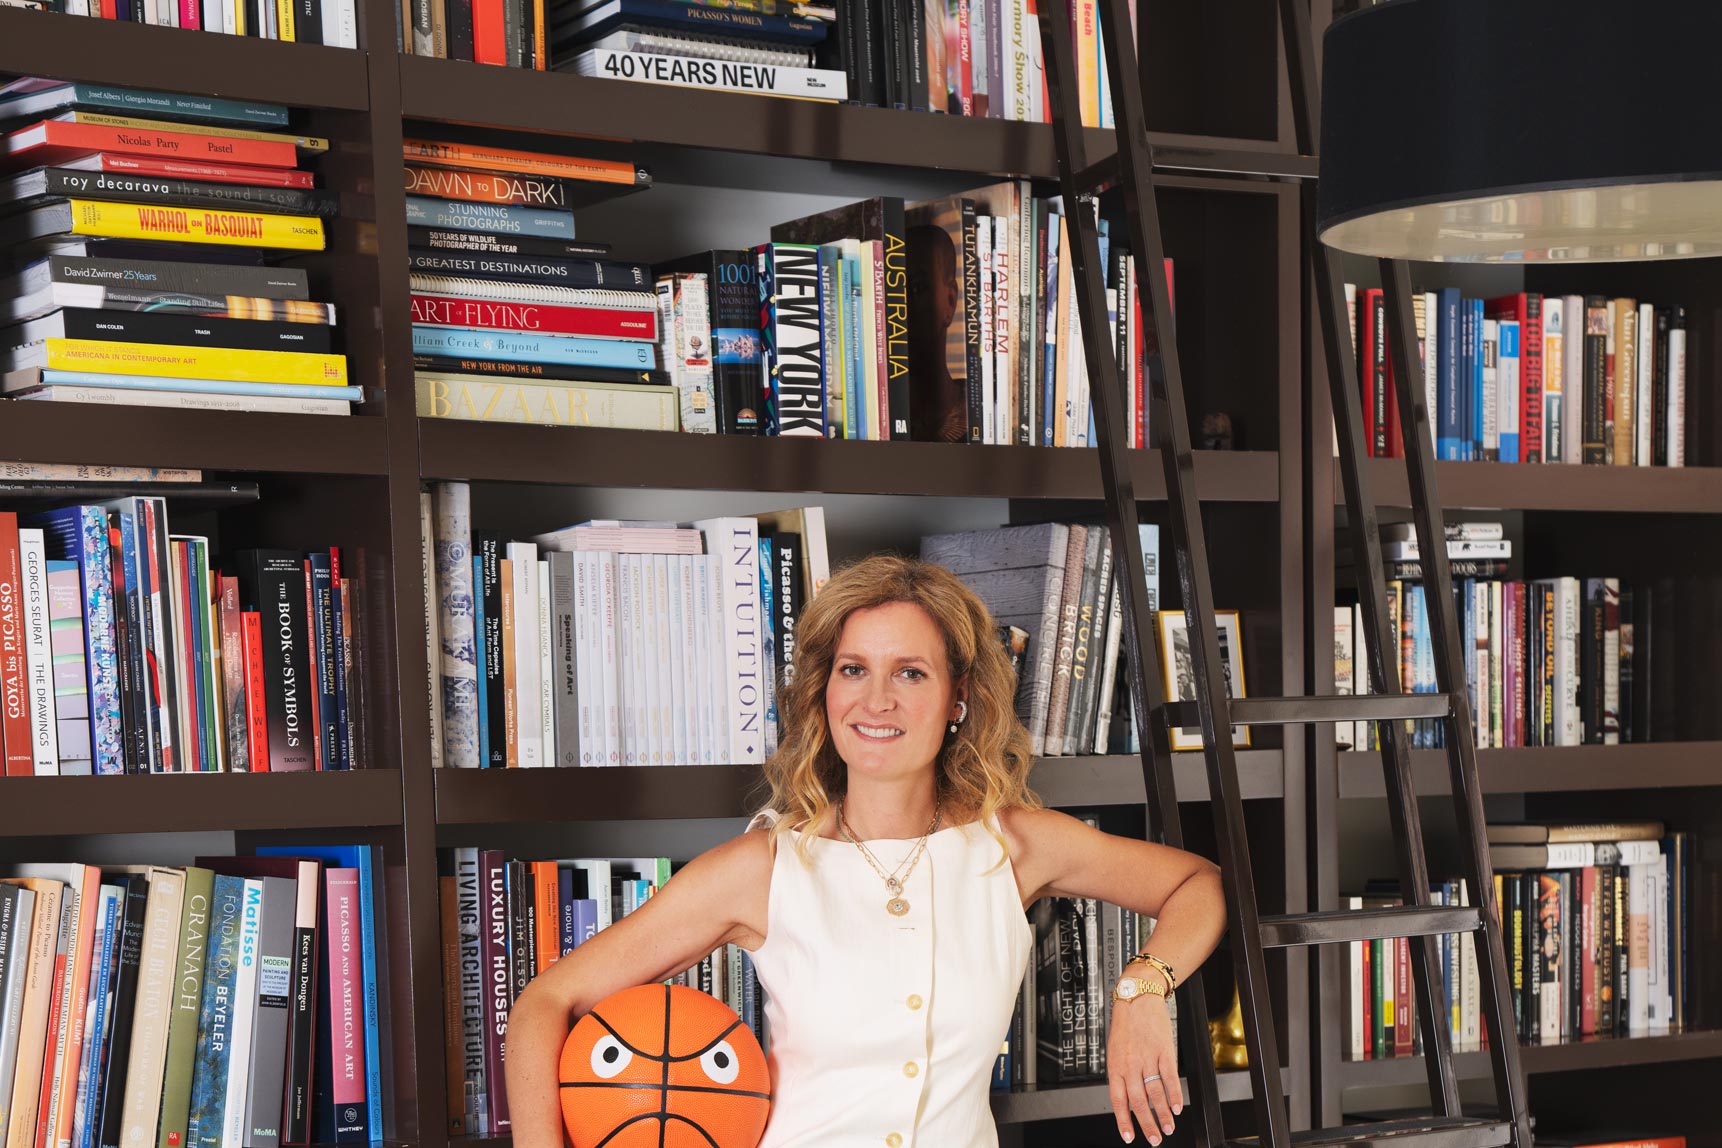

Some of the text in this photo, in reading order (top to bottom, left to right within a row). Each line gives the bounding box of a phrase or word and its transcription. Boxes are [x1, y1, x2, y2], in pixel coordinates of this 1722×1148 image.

[731, 14, 762, 26] WOMEN
[605, 54, 776, 89] 40 YEARS NEW
[118, 135, 233, 153] Nicolas Party Pastel
[63, 175, 169, 193] roy decarava
[404, 168, 472, 195] DAWN
[494, 178, 558, 205] DARK
[138, 208, 190, 234] WARHOL
[205, 216, 263, 239] BASQUIAT
[292, 227, 317, 235] TASCHEN
[438, 214, 520, 232] PHOTOGRAPHS
[449, 204, 508, 218] STUNNING
[535, 219, 565, 228] GRIFFITHS
[64, 267, 89, 277] David
[91, 268, 122, 279] Zwirner
[417, 257, 567, 276] GREATEST DESTINATIONS
[964, 225, 978, 345] TUTANKHAMUN
[411, 300, 455, 322] ART
[466, 304, 539, 329] FLYING
[885, 233, 909, 379] AUSTRALIA
[997, 253, 1009, 354] HARLEM
[66, 351, 110, 359] AMERICANA
[122, 355, 181, 364] CONTEMPORARY
[774, 247, 825, 437] NEW YORK
[462, 361, 542, 374] NEW YORK FROM THE AIR
[426, 380, 590, 425] BAZAAR
[28, 552, 49, 746] GEORGES SEURAT THE DRAWINGS
[279, 602, 293, 651] BOOK
[325, 608, 333, 654] ULTIMATE
[564, 615, 572, 662] Speaking
[733, 528, 758, 733] INTUITION
[1058, 605, 1077, 676] BRICK
[1074, 605, 1092, 680] WOOD
[1, 582, 20, 718] GOYA bis PICASSO
[566, 664, 572, 674] of
[327, 658, 335, 696] TROPHY
[283, 667, 300, 747] SYMBOLS
[242, 887, 261, 967] Matisse
[303, 935, 311, 957] Kees
[340, 897, 349, 952] PICASSO
[181, 895, 207, 1011] CRANACH
[212, 895, 236, 1051] FONDATION BEYELER
[458, 861, 483, 1079] LIVING ARCHITECTURE
[491, 868, 507, 1036] LUXURY HOUSES
[297, 977, 308, 1011] Dongen
[343, 980, 353, 1049] AMERICAN
[1060, 919, 1074, 1069] THE LIGHT OF NEW
[345, 1053, 353, 1079] ART
